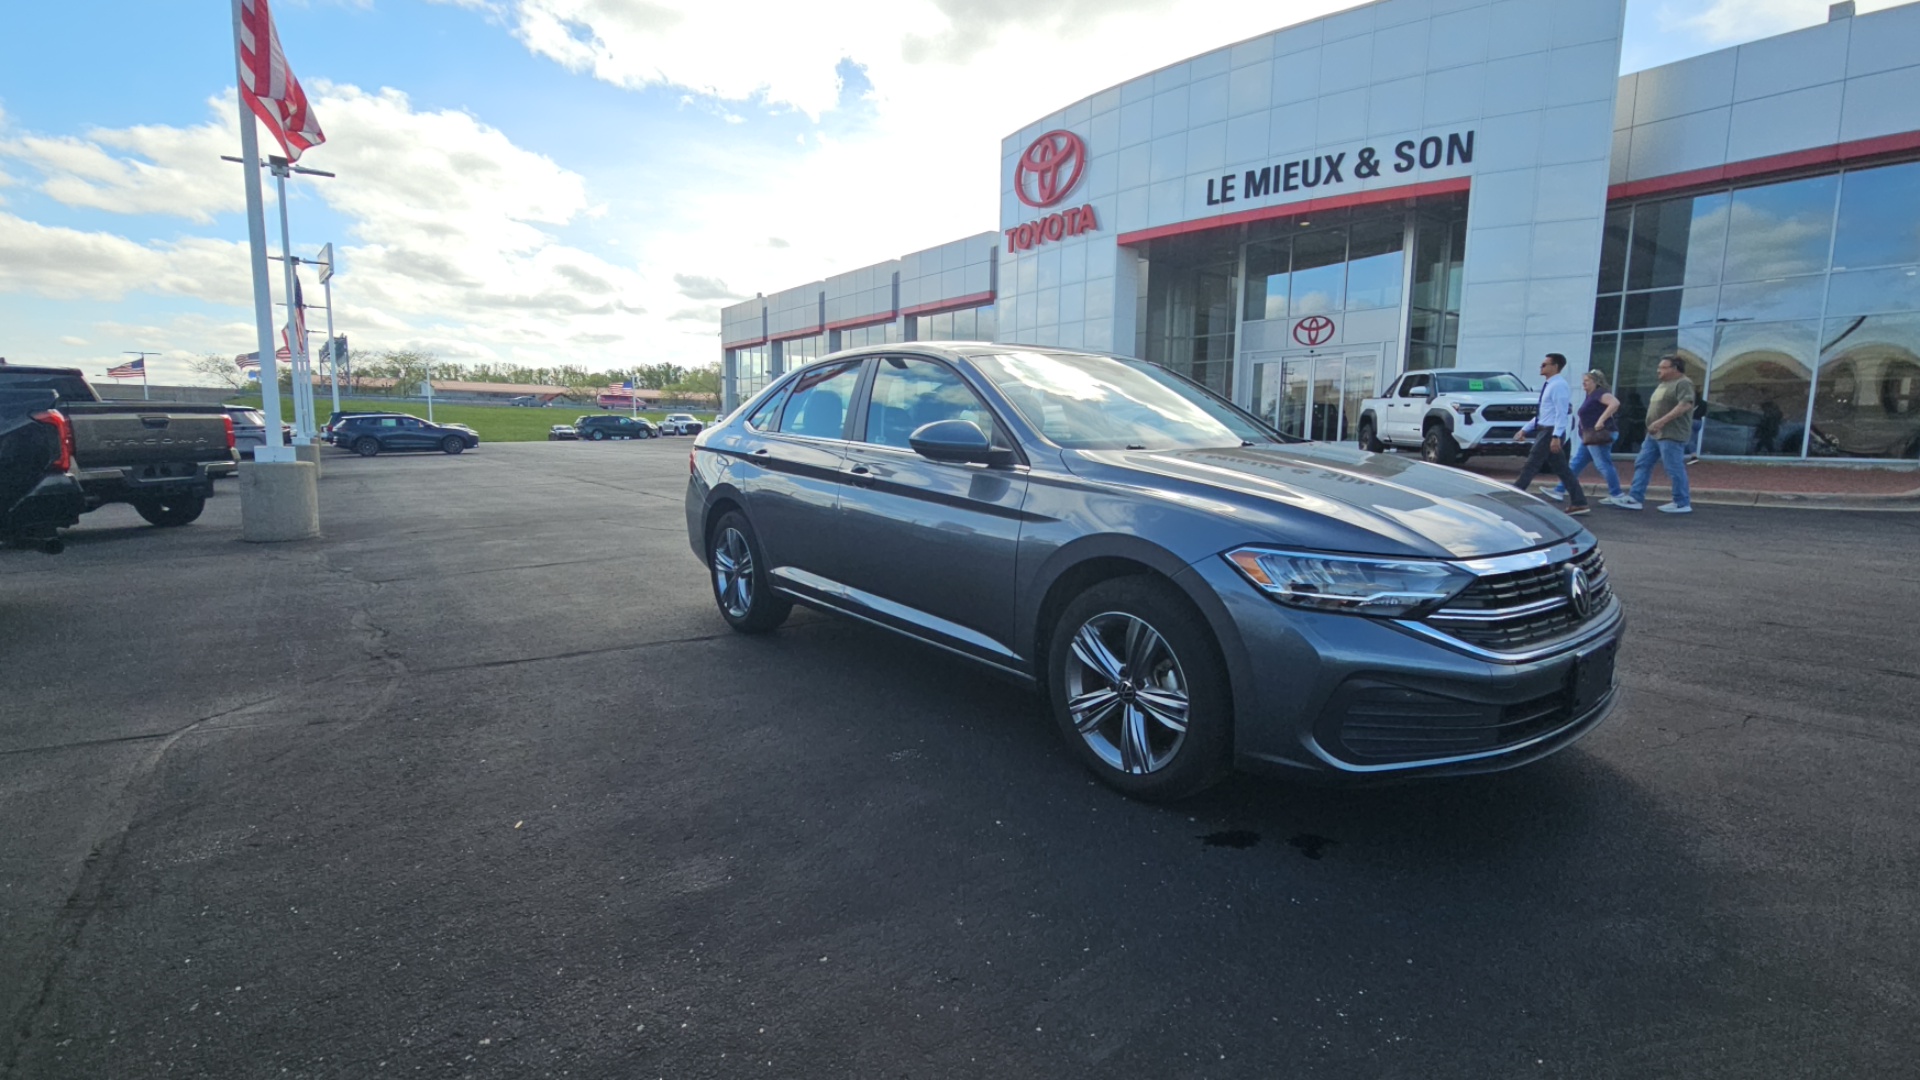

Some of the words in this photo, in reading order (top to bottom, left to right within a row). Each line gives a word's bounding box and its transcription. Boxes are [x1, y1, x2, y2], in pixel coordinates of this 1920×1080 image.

[1207, 174, 1236, 206] LE
[1244, 152, 1346, 199] MIEUX
[1354, 147, 1380, 178] &
[1393, 130, 1475, 173] SON
[1005, 204, 1097, 253] TOYOTA
[104, 437, 208, 447] TACOMA
